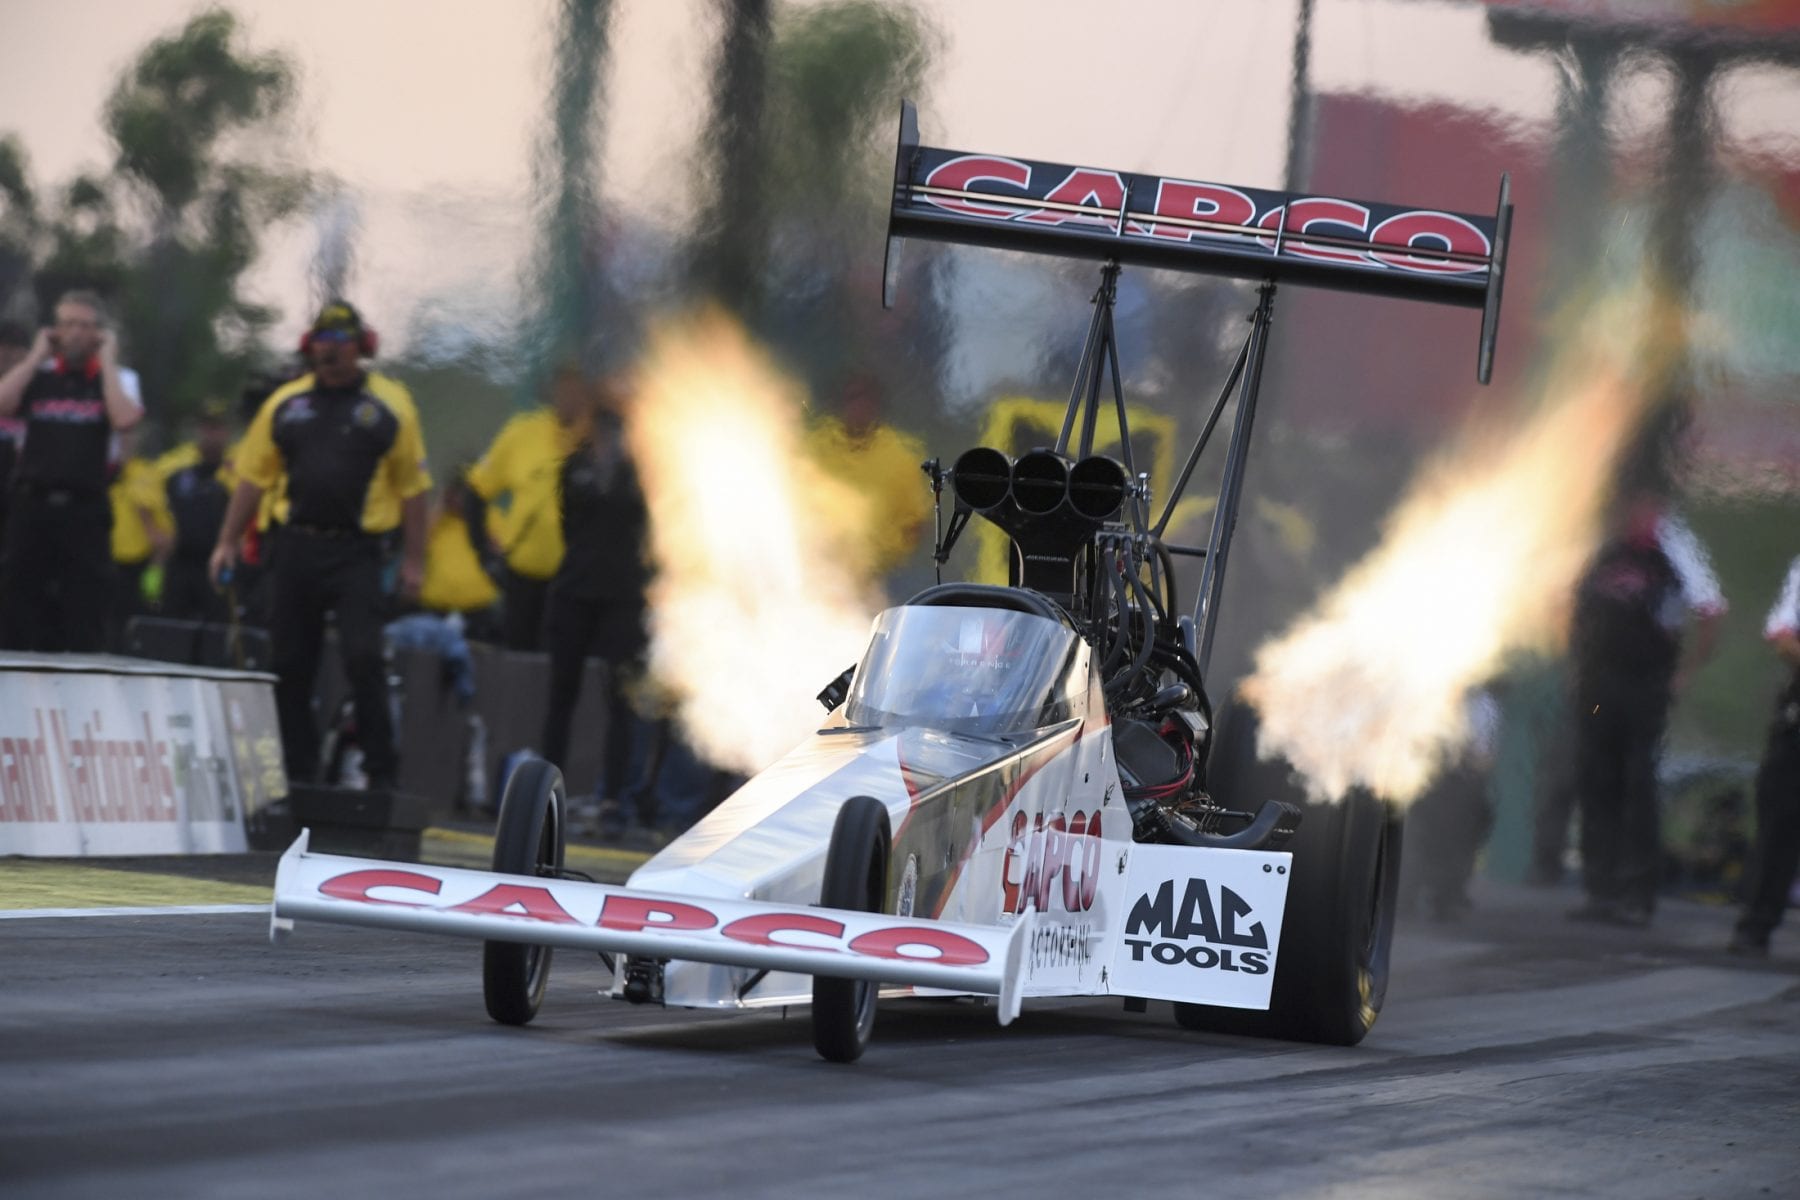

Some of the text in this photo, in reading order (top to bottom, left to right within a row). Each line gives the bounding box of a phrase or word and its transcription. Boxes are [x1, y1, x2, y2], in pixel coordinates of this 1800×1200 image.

[924, 155, 1492, 273] CAPCO
[1002, 809, 1102, 914] CAPCO
[317, 868, 990, 966] CAPCO
[1124, 938, 1270, 975] TOOLS
[1125, 877, 1268, 950] MAC
